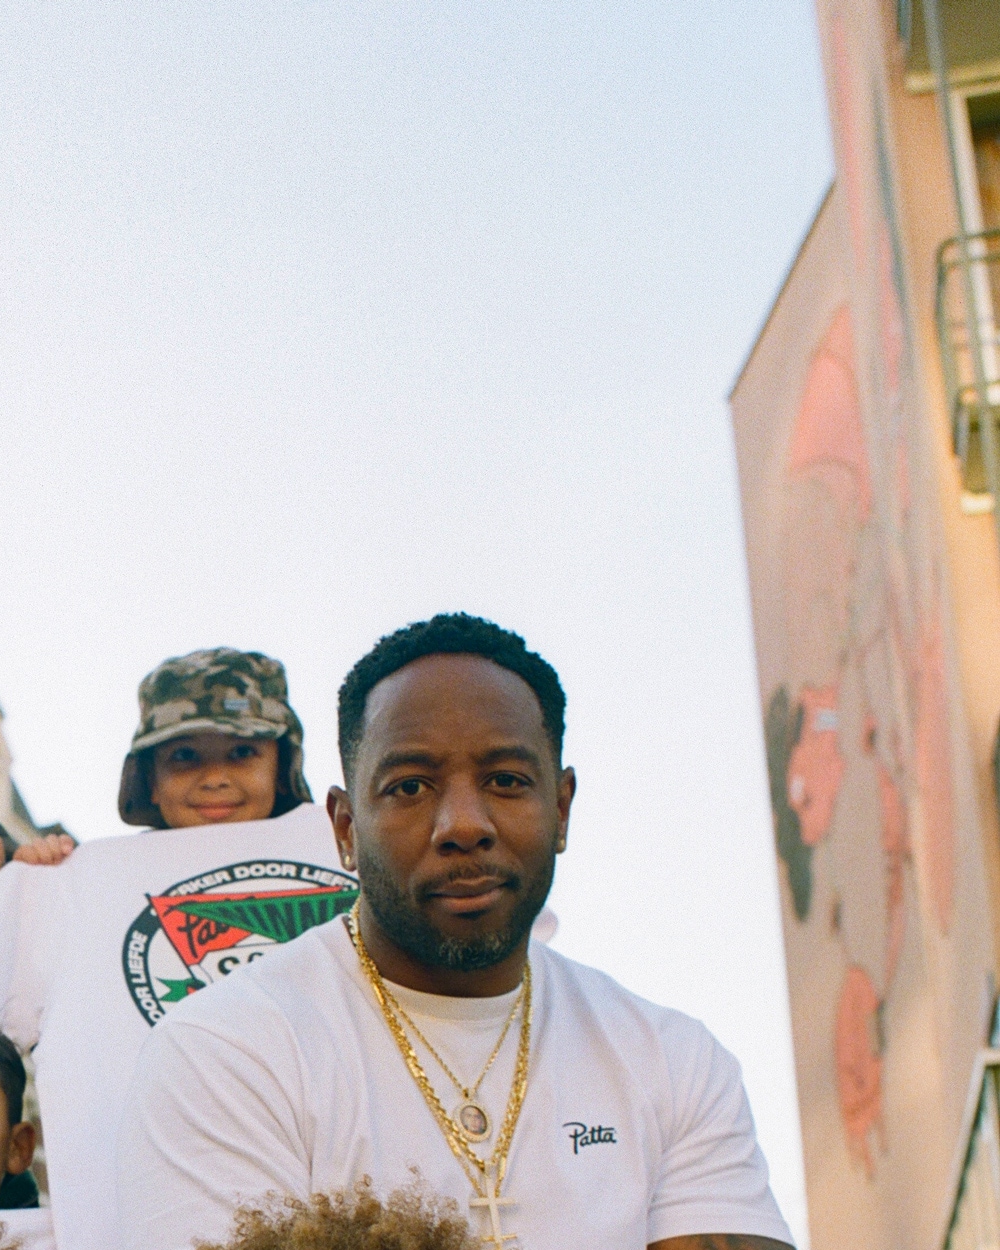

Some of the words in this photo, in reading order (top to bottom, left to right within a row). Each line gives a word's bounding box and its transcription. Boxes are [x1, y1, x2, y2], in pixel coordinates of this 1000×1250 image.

[170, 869, 232, 897] RKER
[233, 863, 297, 879] DOOR
[300, 866, 358, 892] LIEF
[127, 930, 149, 984] LIEFDE
[135, 986, 162, 1023] OOR
[562, 1121, 617, 1155] Patta
